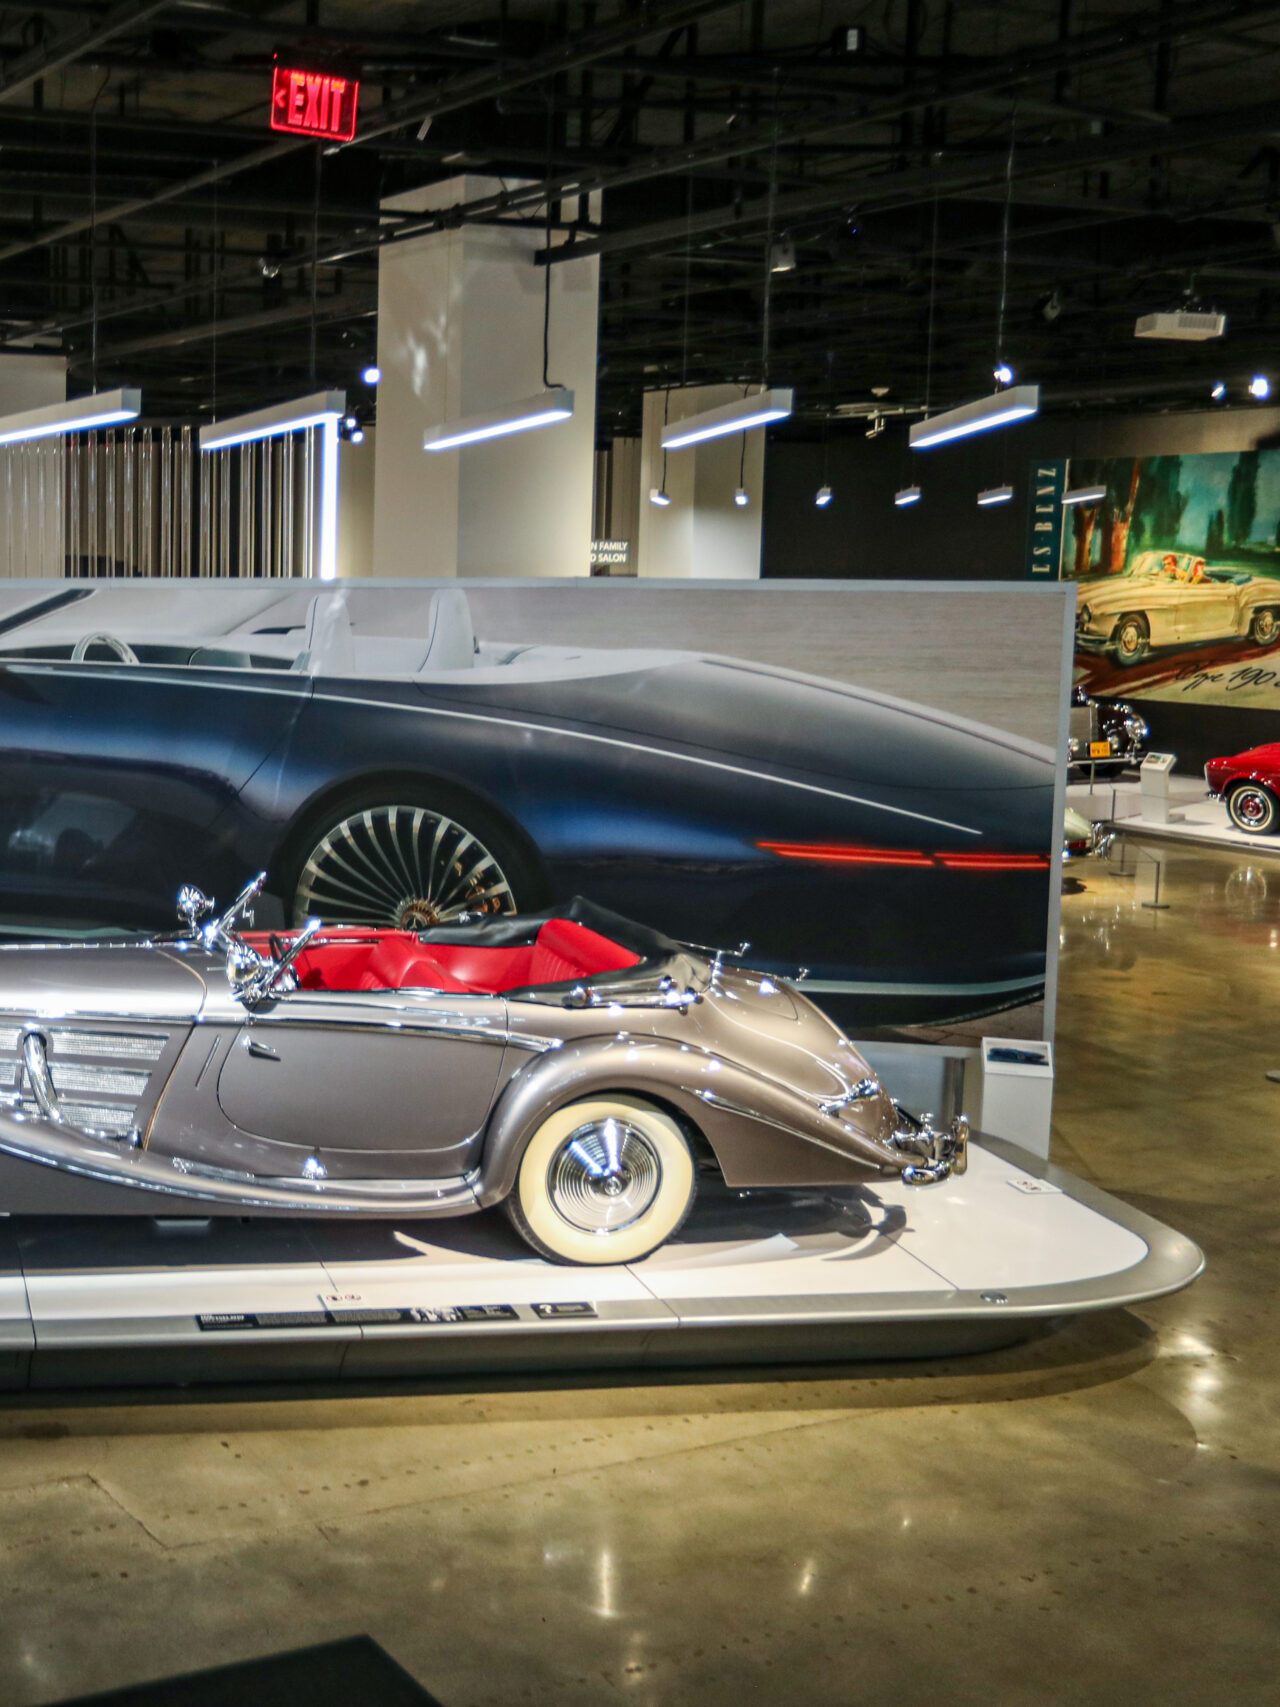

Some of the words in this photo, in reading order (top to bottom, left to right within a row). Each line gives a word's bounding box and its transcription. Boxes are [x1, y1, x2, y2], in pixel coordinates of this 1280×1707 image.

[287, 72, 346, 132] EXIT
[600, 541, 628, 551] FAMILY
[599, 553, 626, 563] SALON
